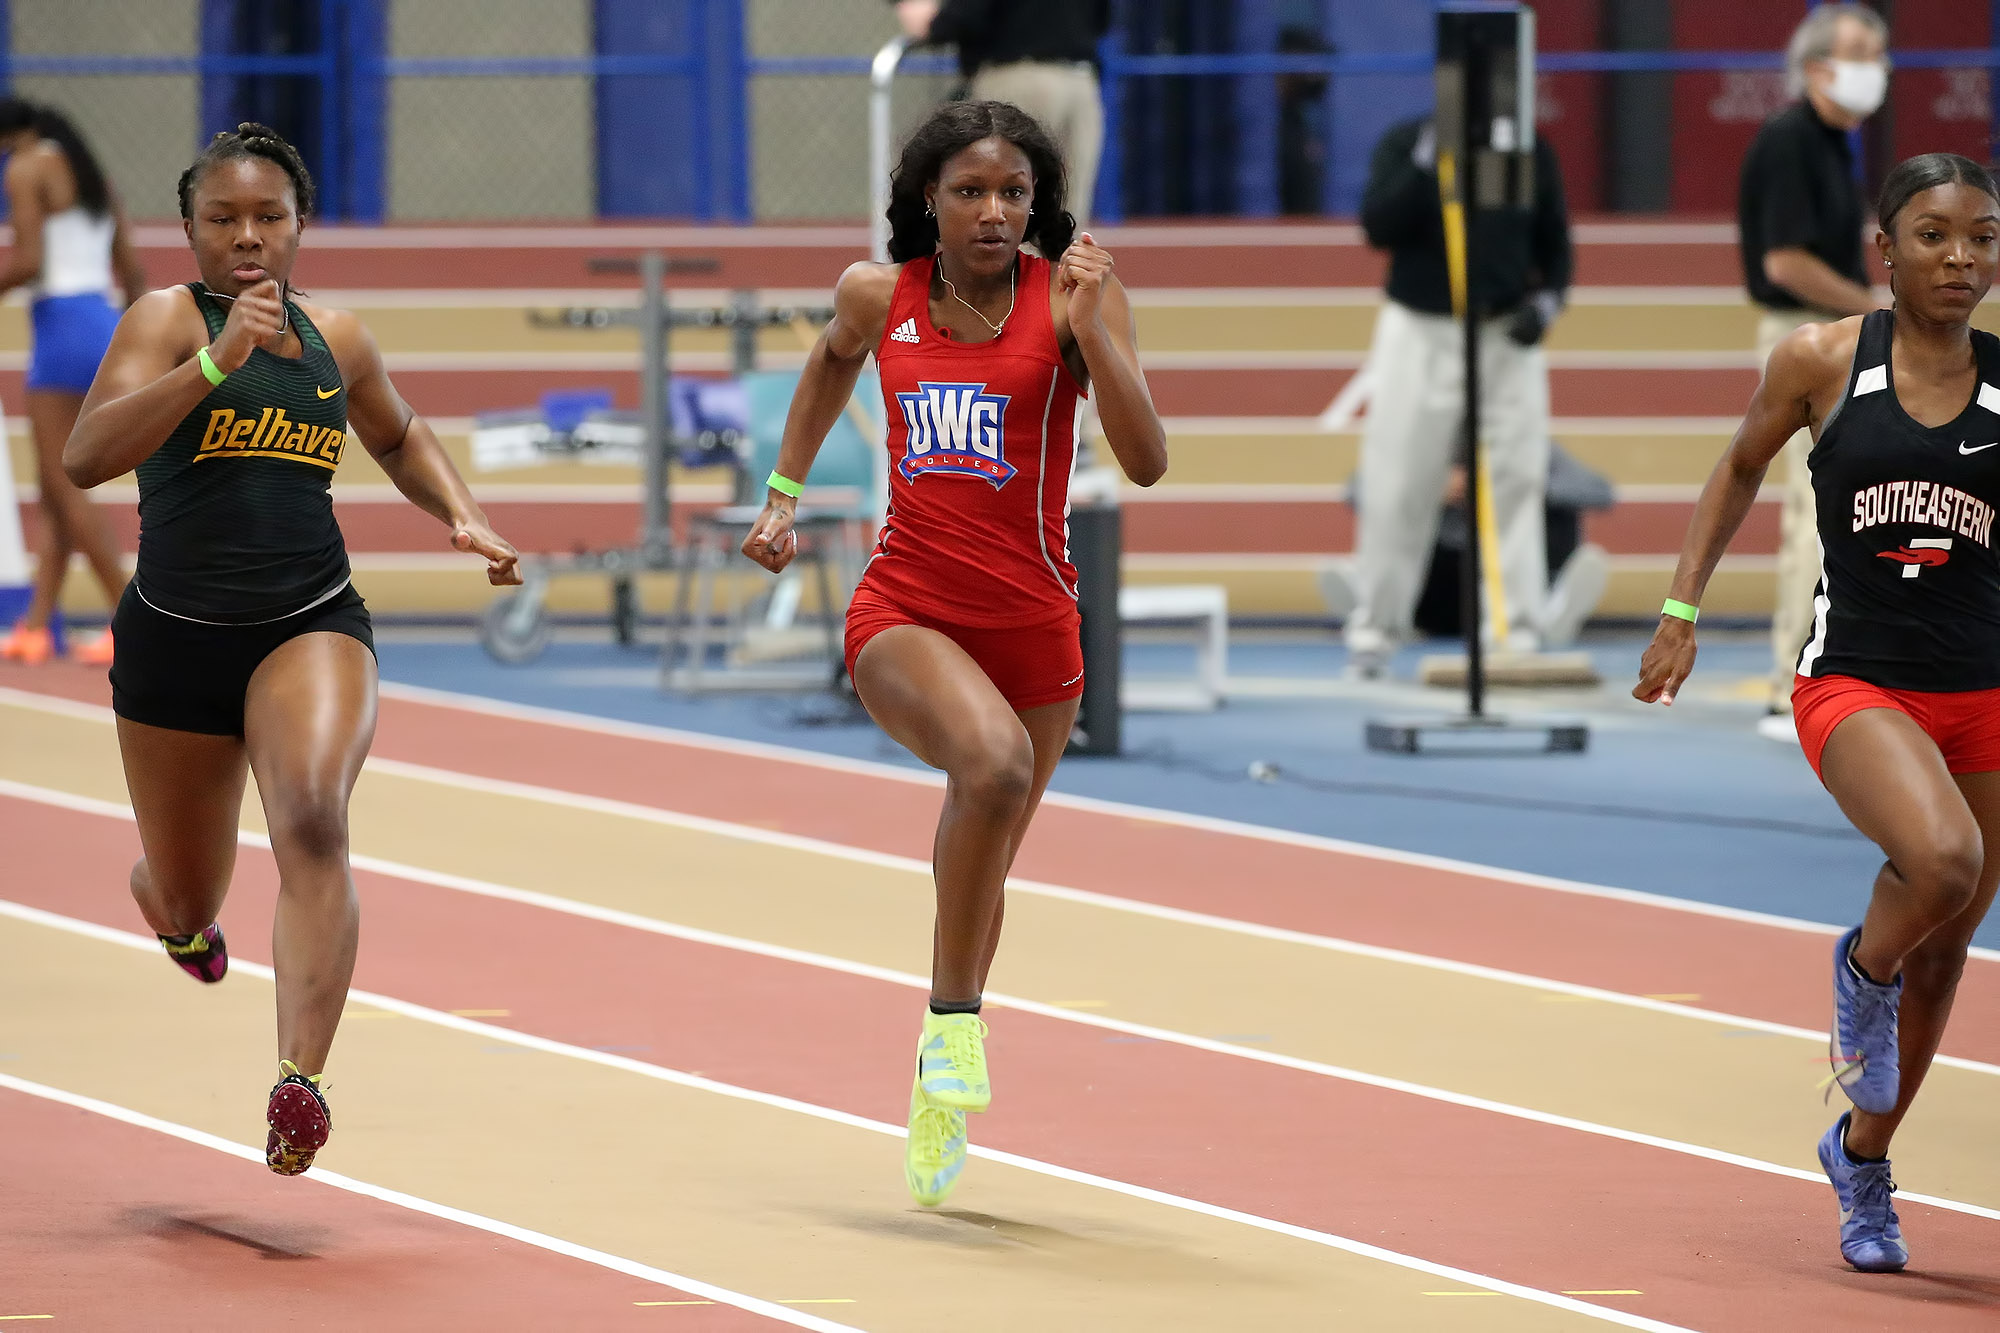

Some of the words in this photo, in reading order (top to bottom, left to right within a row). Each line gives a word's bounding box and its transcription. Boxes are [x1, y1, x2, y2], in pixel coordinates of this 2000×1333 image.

[890, 332, 920, 343] adidas
[904, 388, 998, 460] UWG
[909, 456, 999, 474] WOLVES
[1852, 481, 1995, 549] SOUTHEASTERN
